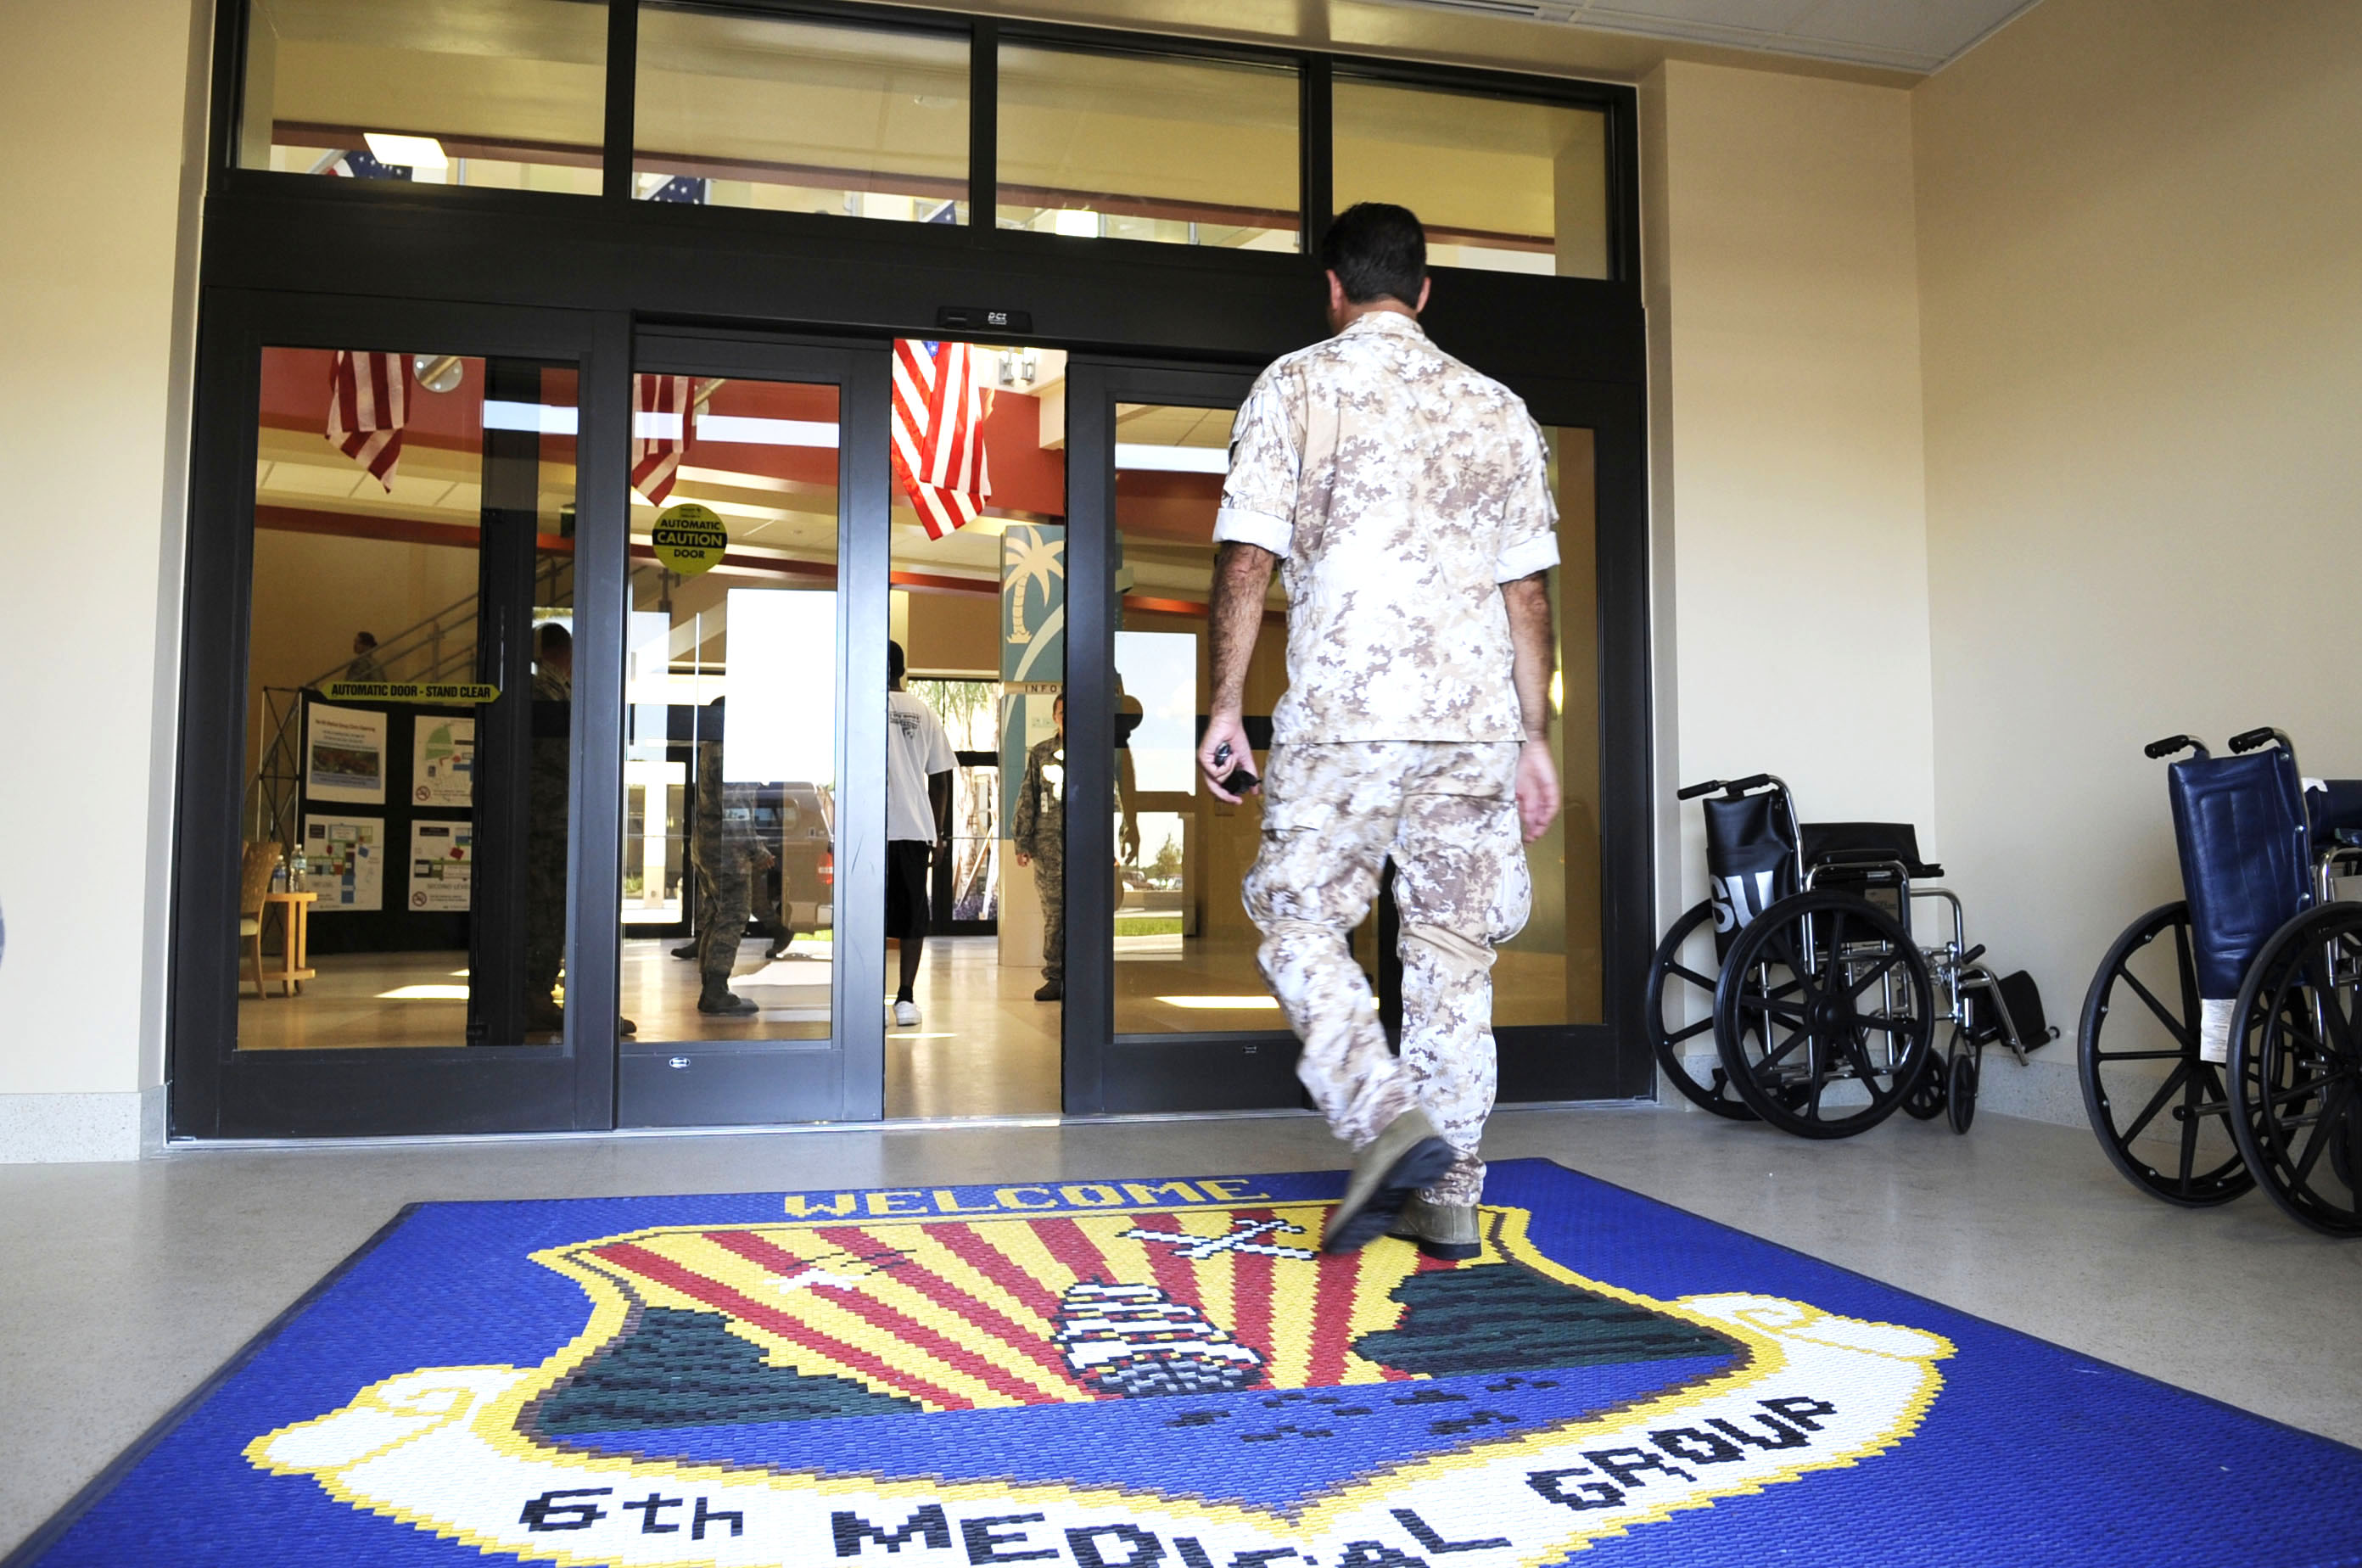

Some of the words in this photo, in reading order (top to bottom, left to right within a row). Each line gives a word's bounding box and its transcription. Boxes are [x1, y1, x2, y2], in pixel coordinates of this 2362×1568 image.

[660, 518, 720, 530] AUTOMATIC
[658, 531, 723, 546] CAUTION
[674, 549, 706, 559] DOOR
[331, 684, 389, 696] AUTOMATIC
[390, 685, 417, 697] DOOR
[426, 686, 459, 697] STAND
[460, 686, 490, 698] CLEAR
[1025, 685, 1064, 693] INFO
[784, 1179, 1270, 1218] WELCOME
[518, 1487, 743, 1540] 6th
[1525, 1396, 1838, 1511] GROUP
